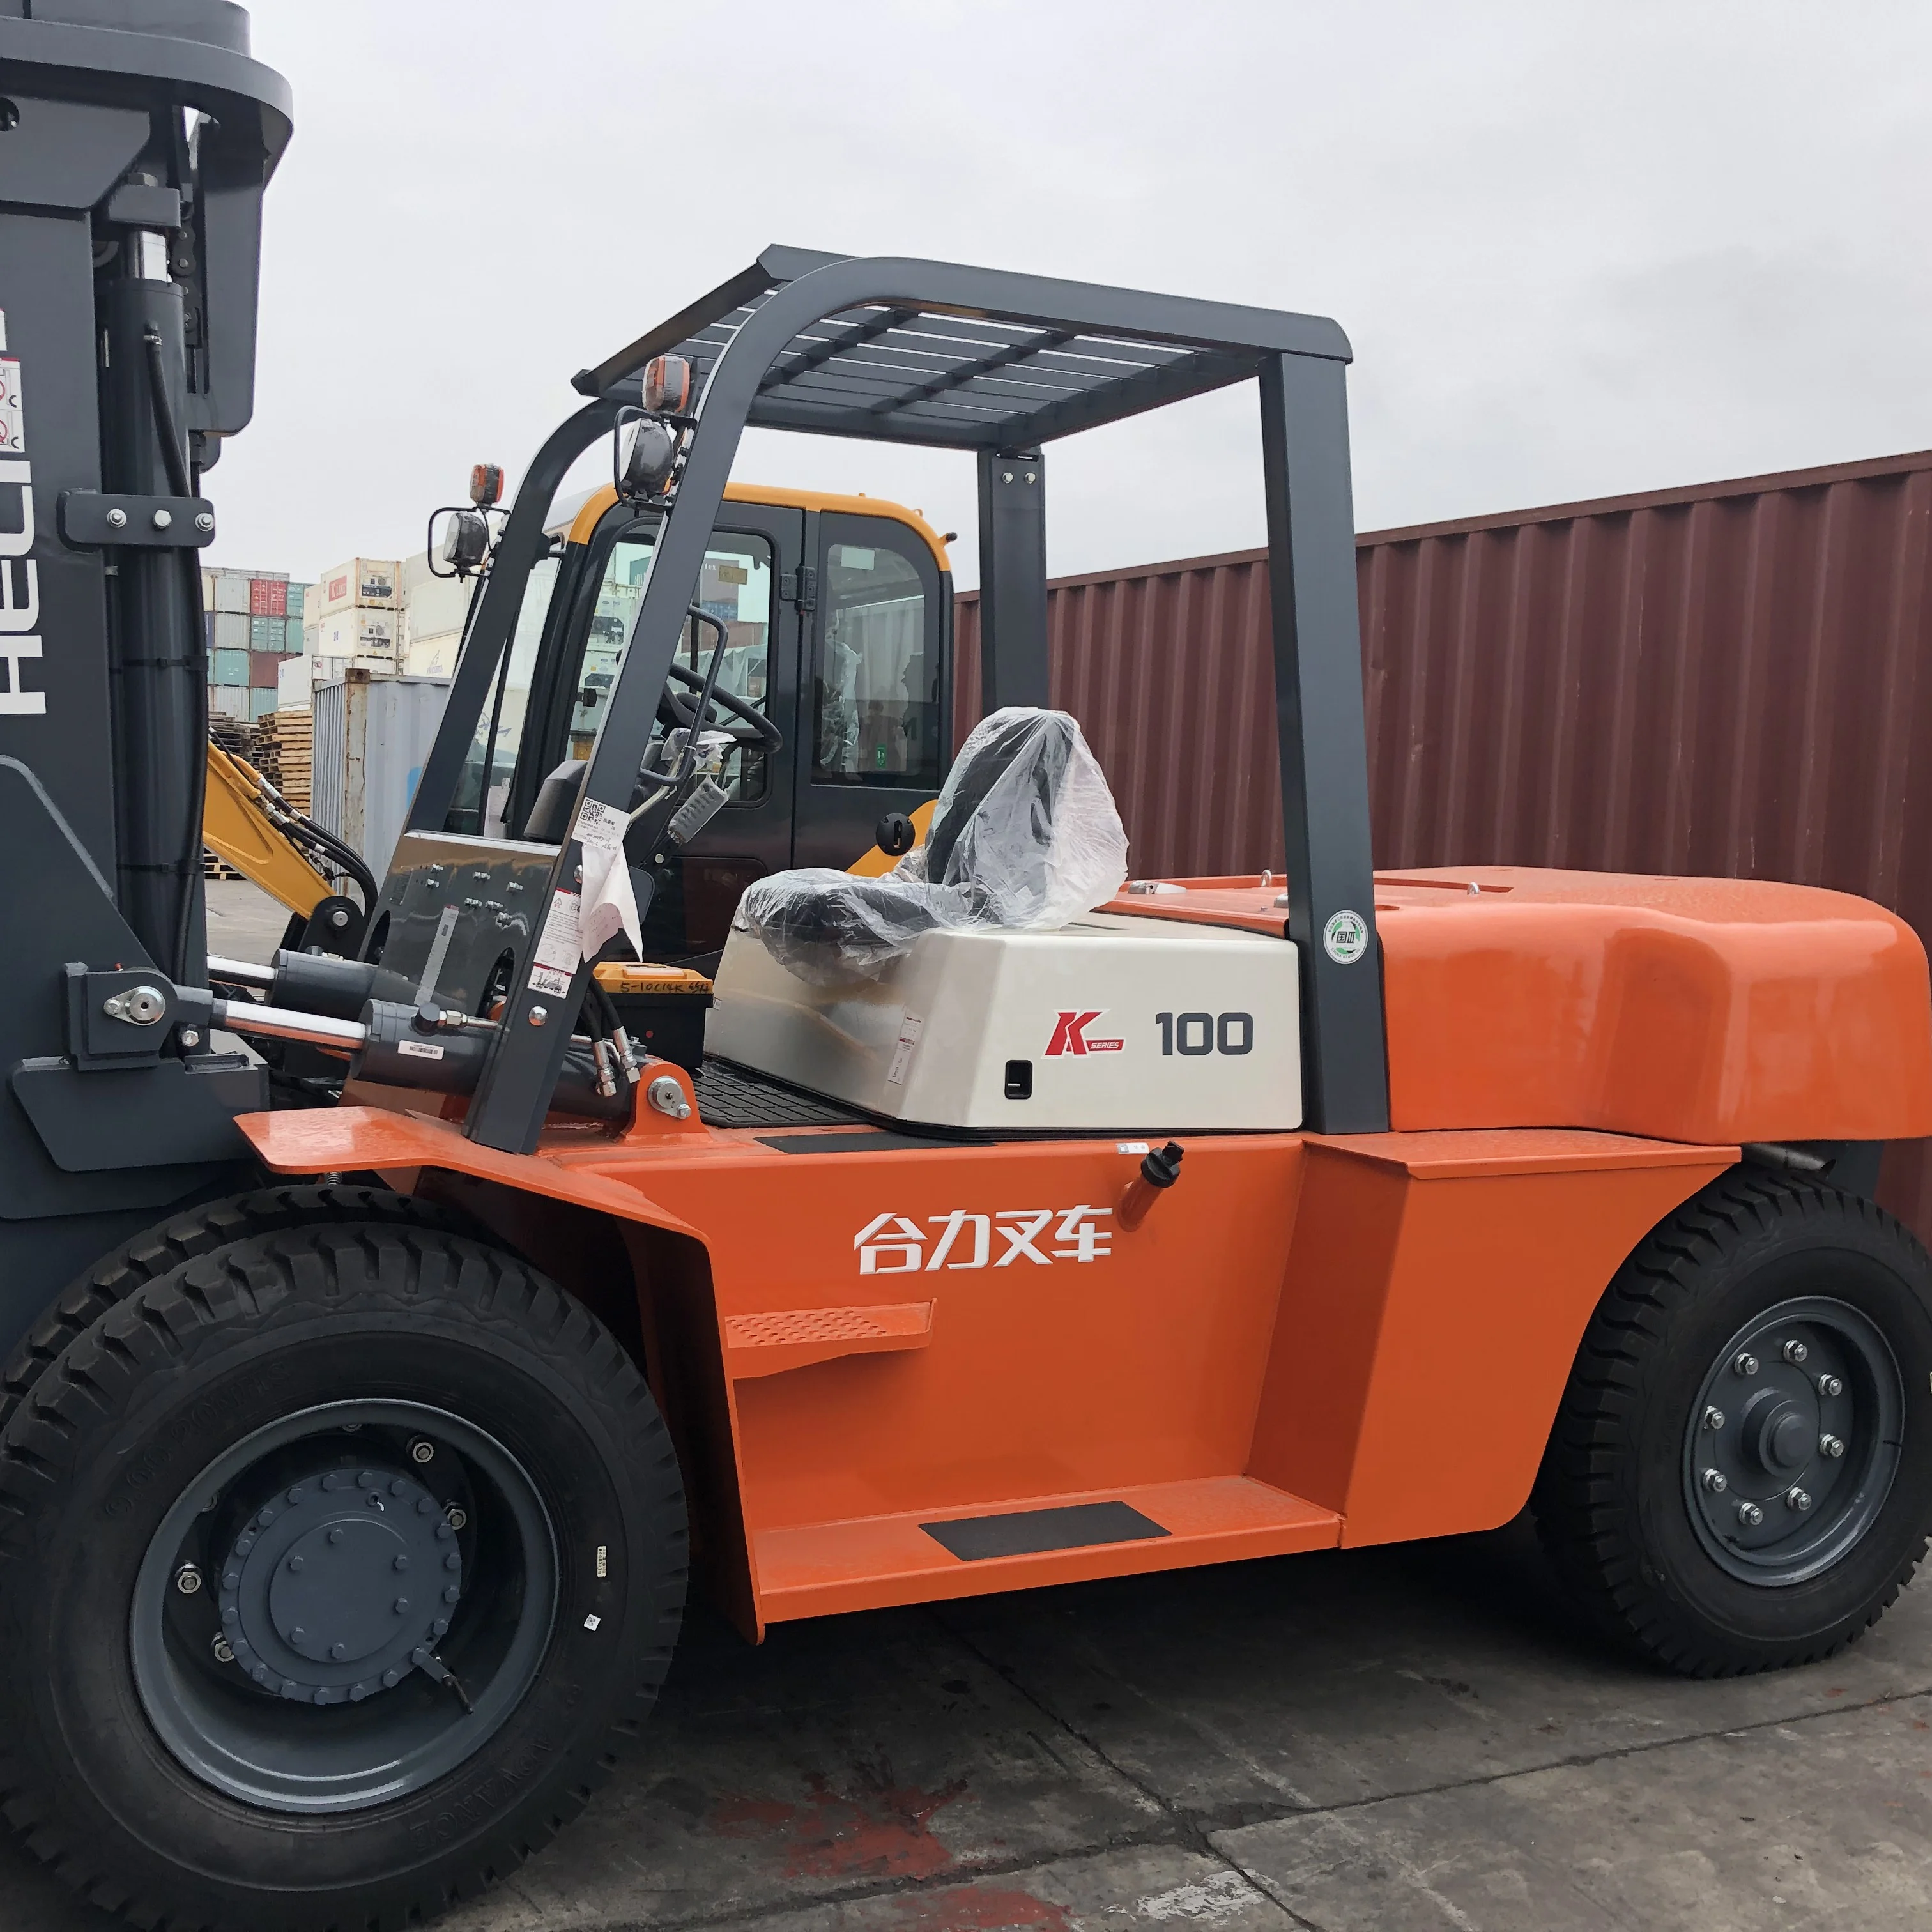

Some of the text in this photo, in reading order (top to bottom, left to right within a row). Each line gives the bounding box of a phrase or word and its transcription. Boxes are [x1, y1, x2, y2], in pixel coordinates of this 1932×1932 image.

[0, 460, 46, 714] HELI
[1045, 1012, 1103, 1055] K
[1156, 1012, 1254, 1055] 100
[854, 1205, 1113, 1275] 合力叉车
